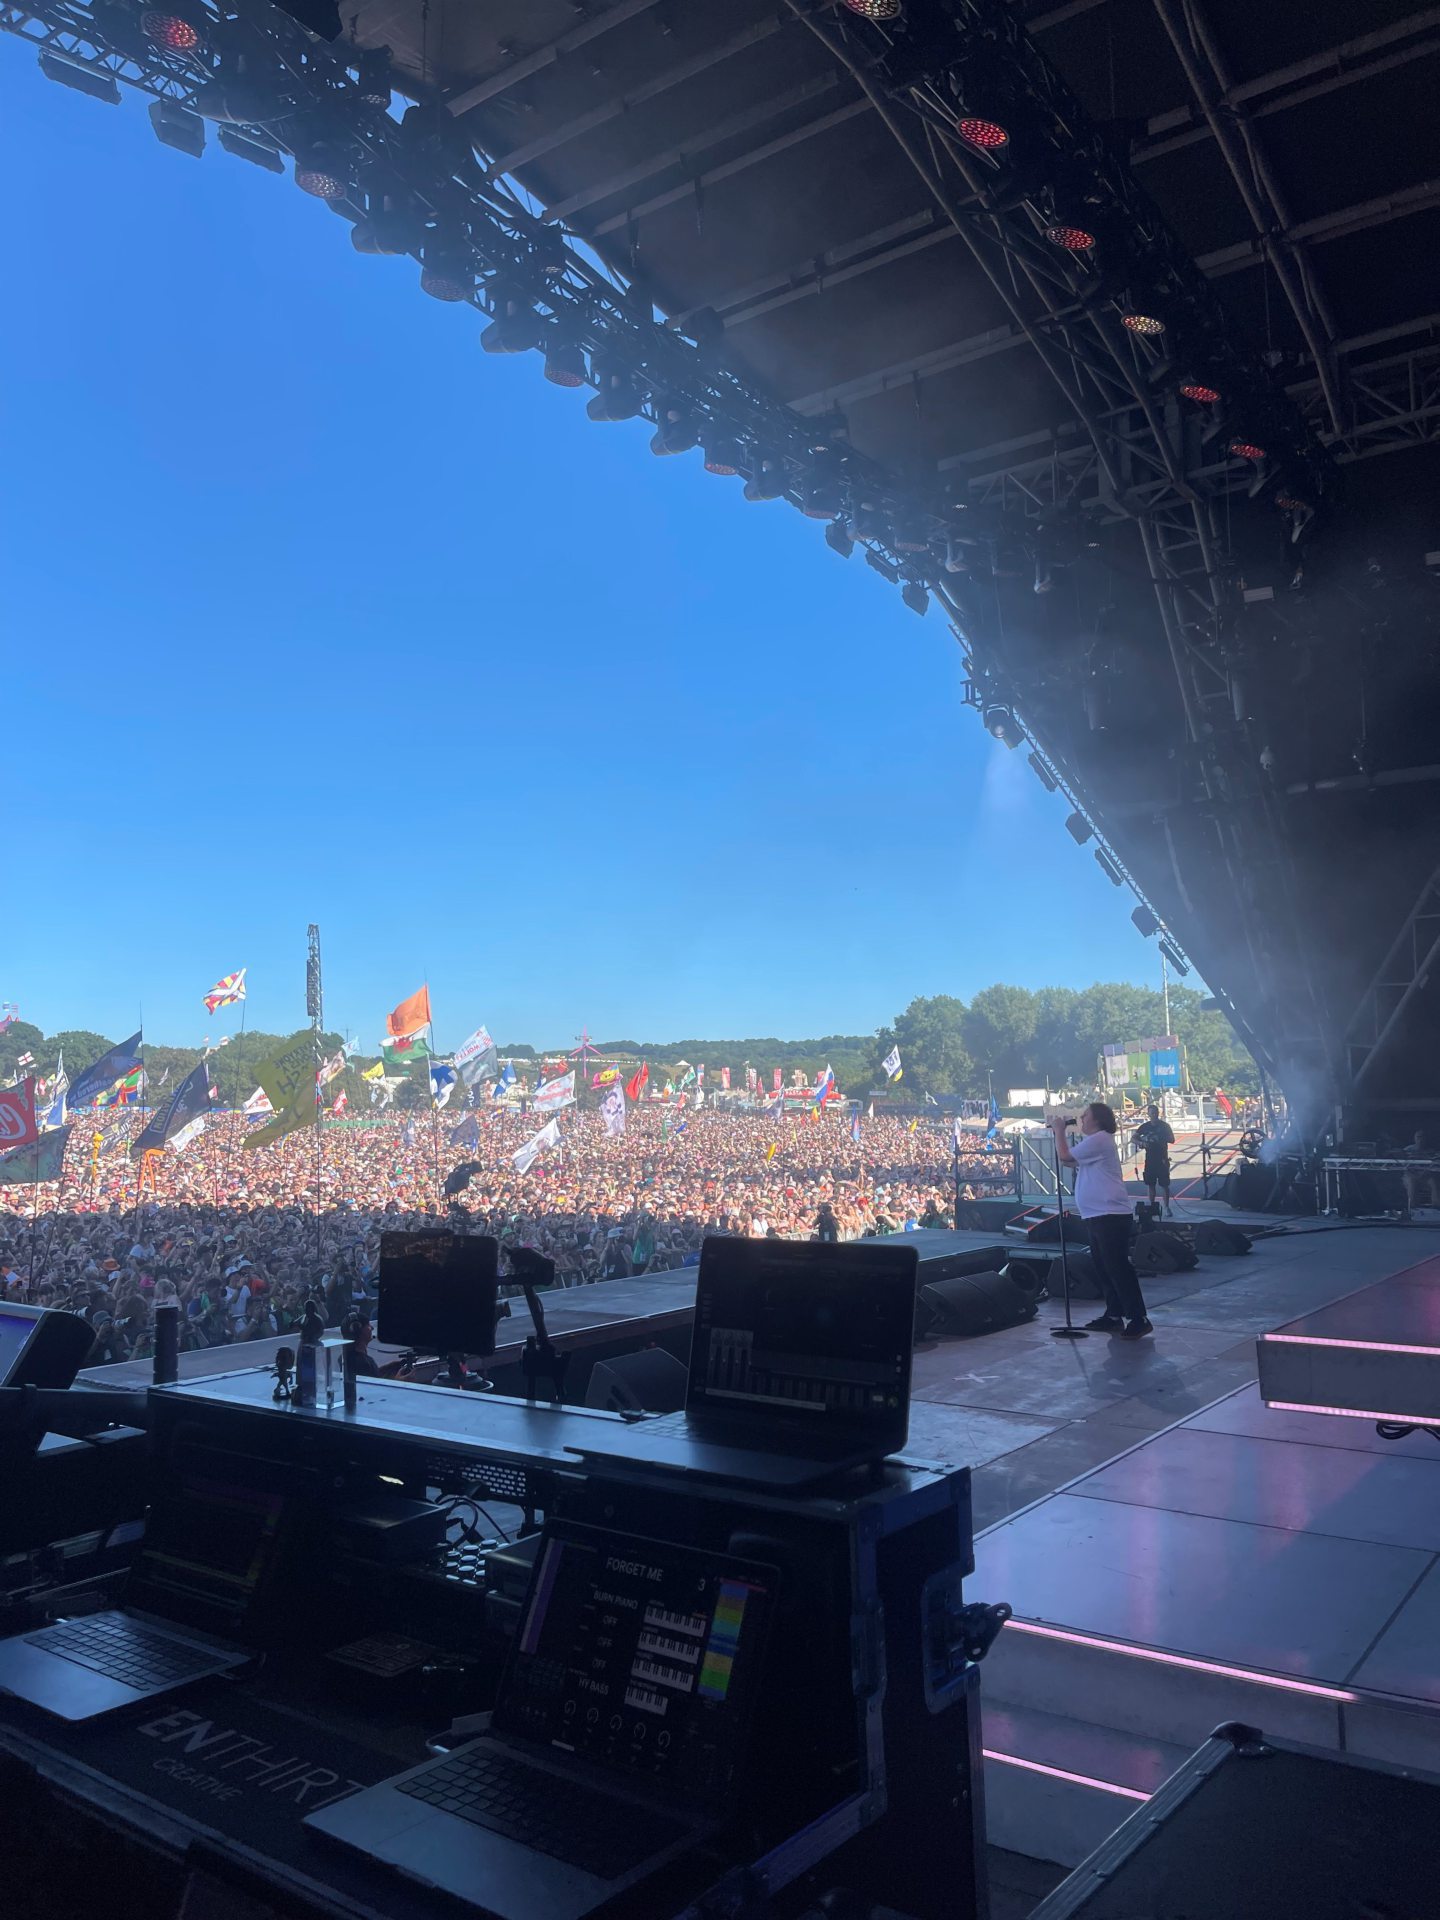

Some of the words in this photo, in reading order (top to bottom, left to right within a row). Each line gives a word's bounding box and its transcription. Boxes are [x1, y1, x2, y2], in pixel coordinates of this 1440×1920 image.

[605, 1557, 647, 1577] FORGET
[646, 1567, 665, 1582] ME
[697, 1578, 706, 1592] 3
[614, 1596, 638, 1610] PIANO
[602, 1615, 618, 1626] OFF
[597, 1637, 613, 1648] OFF
[592, 1657, 607, 1670] OFF
[589, 1681, 610, 1696] BASS
[151, 1758, 244, 1803] CREATIVE
